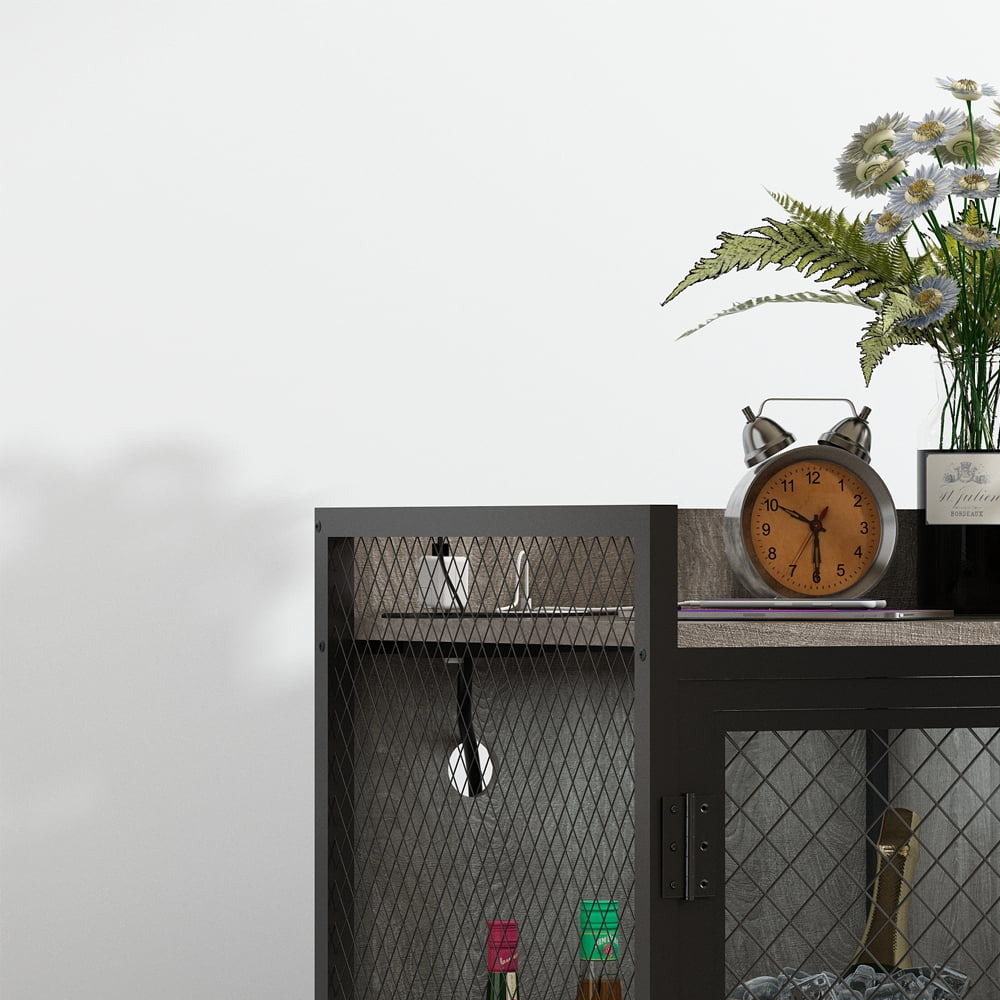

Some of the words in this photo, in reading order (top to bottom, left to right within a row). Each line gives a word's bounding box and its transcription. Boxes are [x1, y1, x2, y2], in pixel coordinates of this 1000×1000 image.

[806, 471, 820, 484] 12
[781, 480, 794, 492] 11
[838, 479, 844, 492] 1
[764, 498, 779, 512] 10
[853, 494, 862, 508] 2
[950, 510, 984, 518] BORDEAUX
[761, 522, 771, 536] 9
[860, 521, 869, 534] 3
[768, 546, 777, 560] 8
[854, 546, 863, 558] 4
[788, 564, 797, 577] 7
[837, 563, 846, 577] 5
[812, 570, 821, 584] 6
